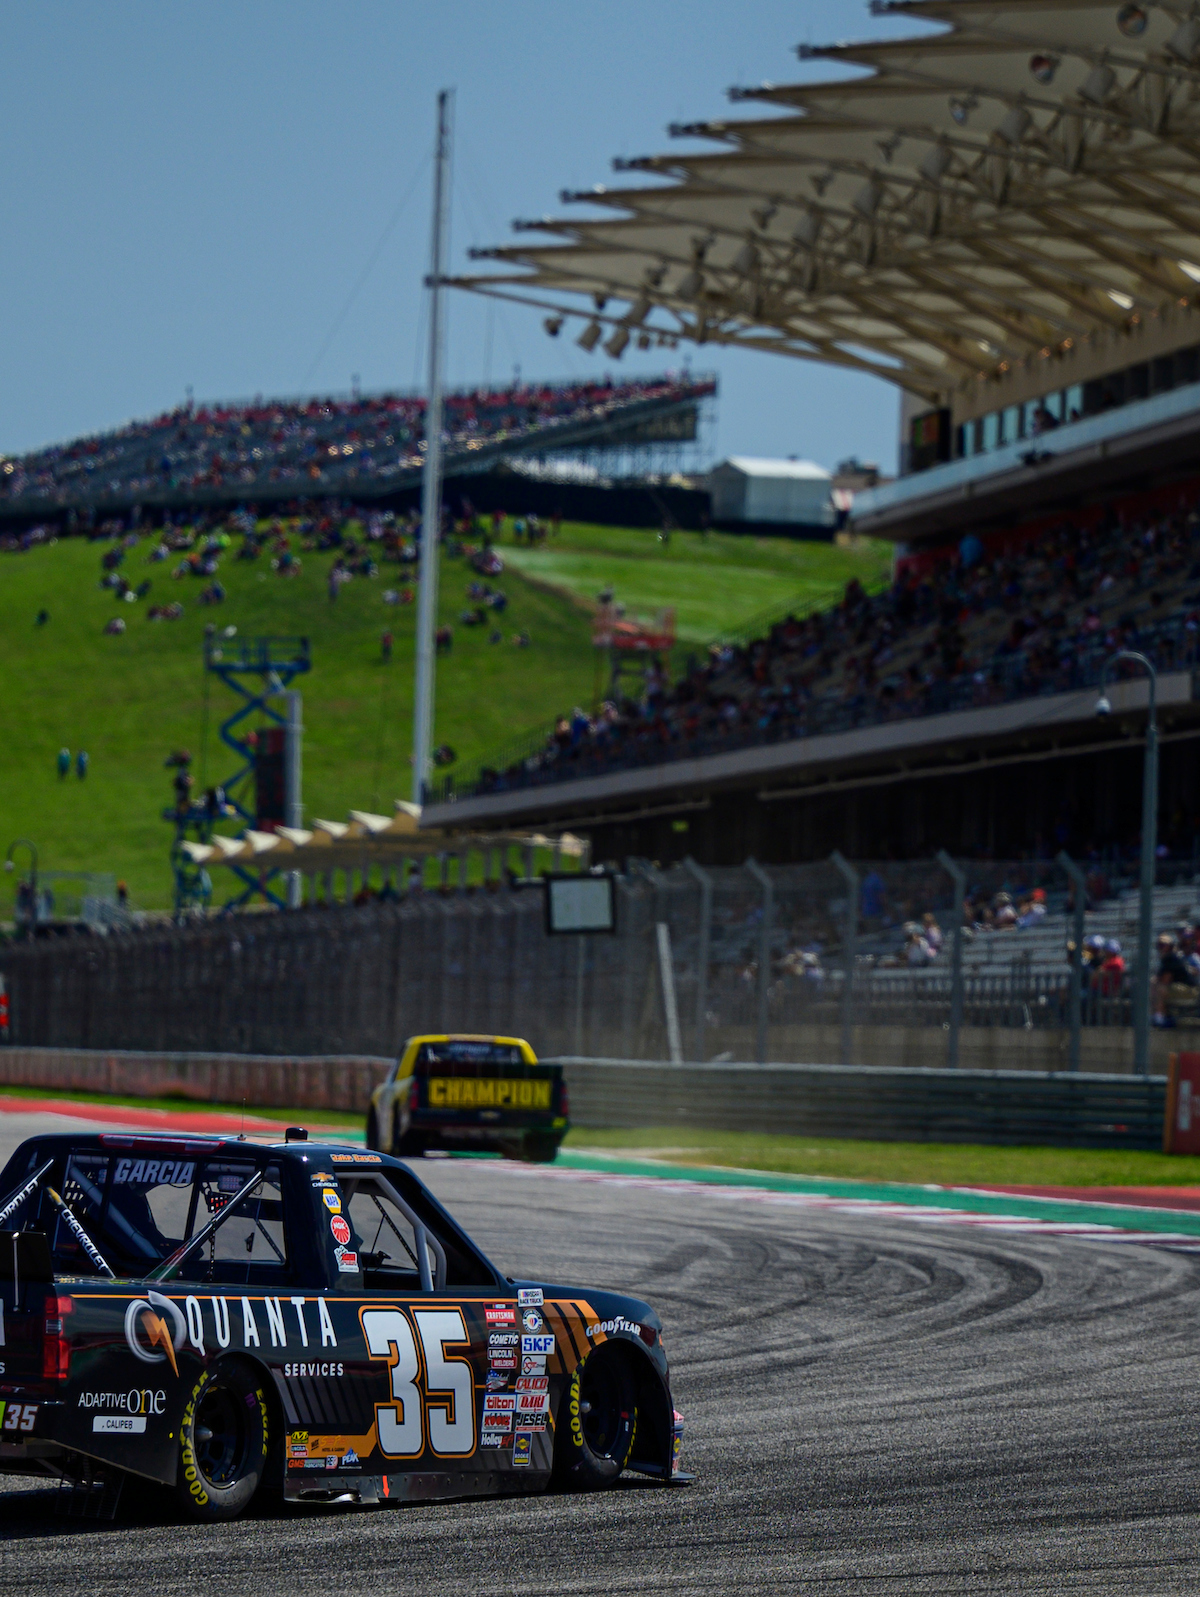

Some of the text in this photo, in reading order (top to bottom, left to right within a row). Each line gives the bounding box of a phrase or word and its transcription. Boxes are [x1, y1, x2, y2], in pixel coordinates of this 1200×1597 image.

[429, 1078, 551, 1110] CHAMPION
[114, 1159, 195, 1184] GARCIA
[325, 1195, 340, 1207] NAPA
[61, 1208, 109, 1270] CHEVROLET
[486, 1311, 515, 1320] CRAFTSMAN
[185, 1295, 338, 1356] QUANTA
[586, 1316, 641, 1338] GOODYEAR
[489, 1333, 519, 1345] COMETIC
[523, 1337, 553, 1351] SKF
[489, 1349, 512, 1358] LINCOLN
[284, 1363, 344, 1377] SERVICES
[358, 1304, 477, 1459] 35
[516, 1378, 548, 1390] CALICO
[486, 1396, 514, 1408] tilton
[4, 1404, 39, 1430] 35
[516, 1413, 546, 1426] JESEL
[481, 1433, 503, 1448] Holley
[288, 1459, 304, 1468] GMS
[341, 1453, 359, 1465] PEAK
